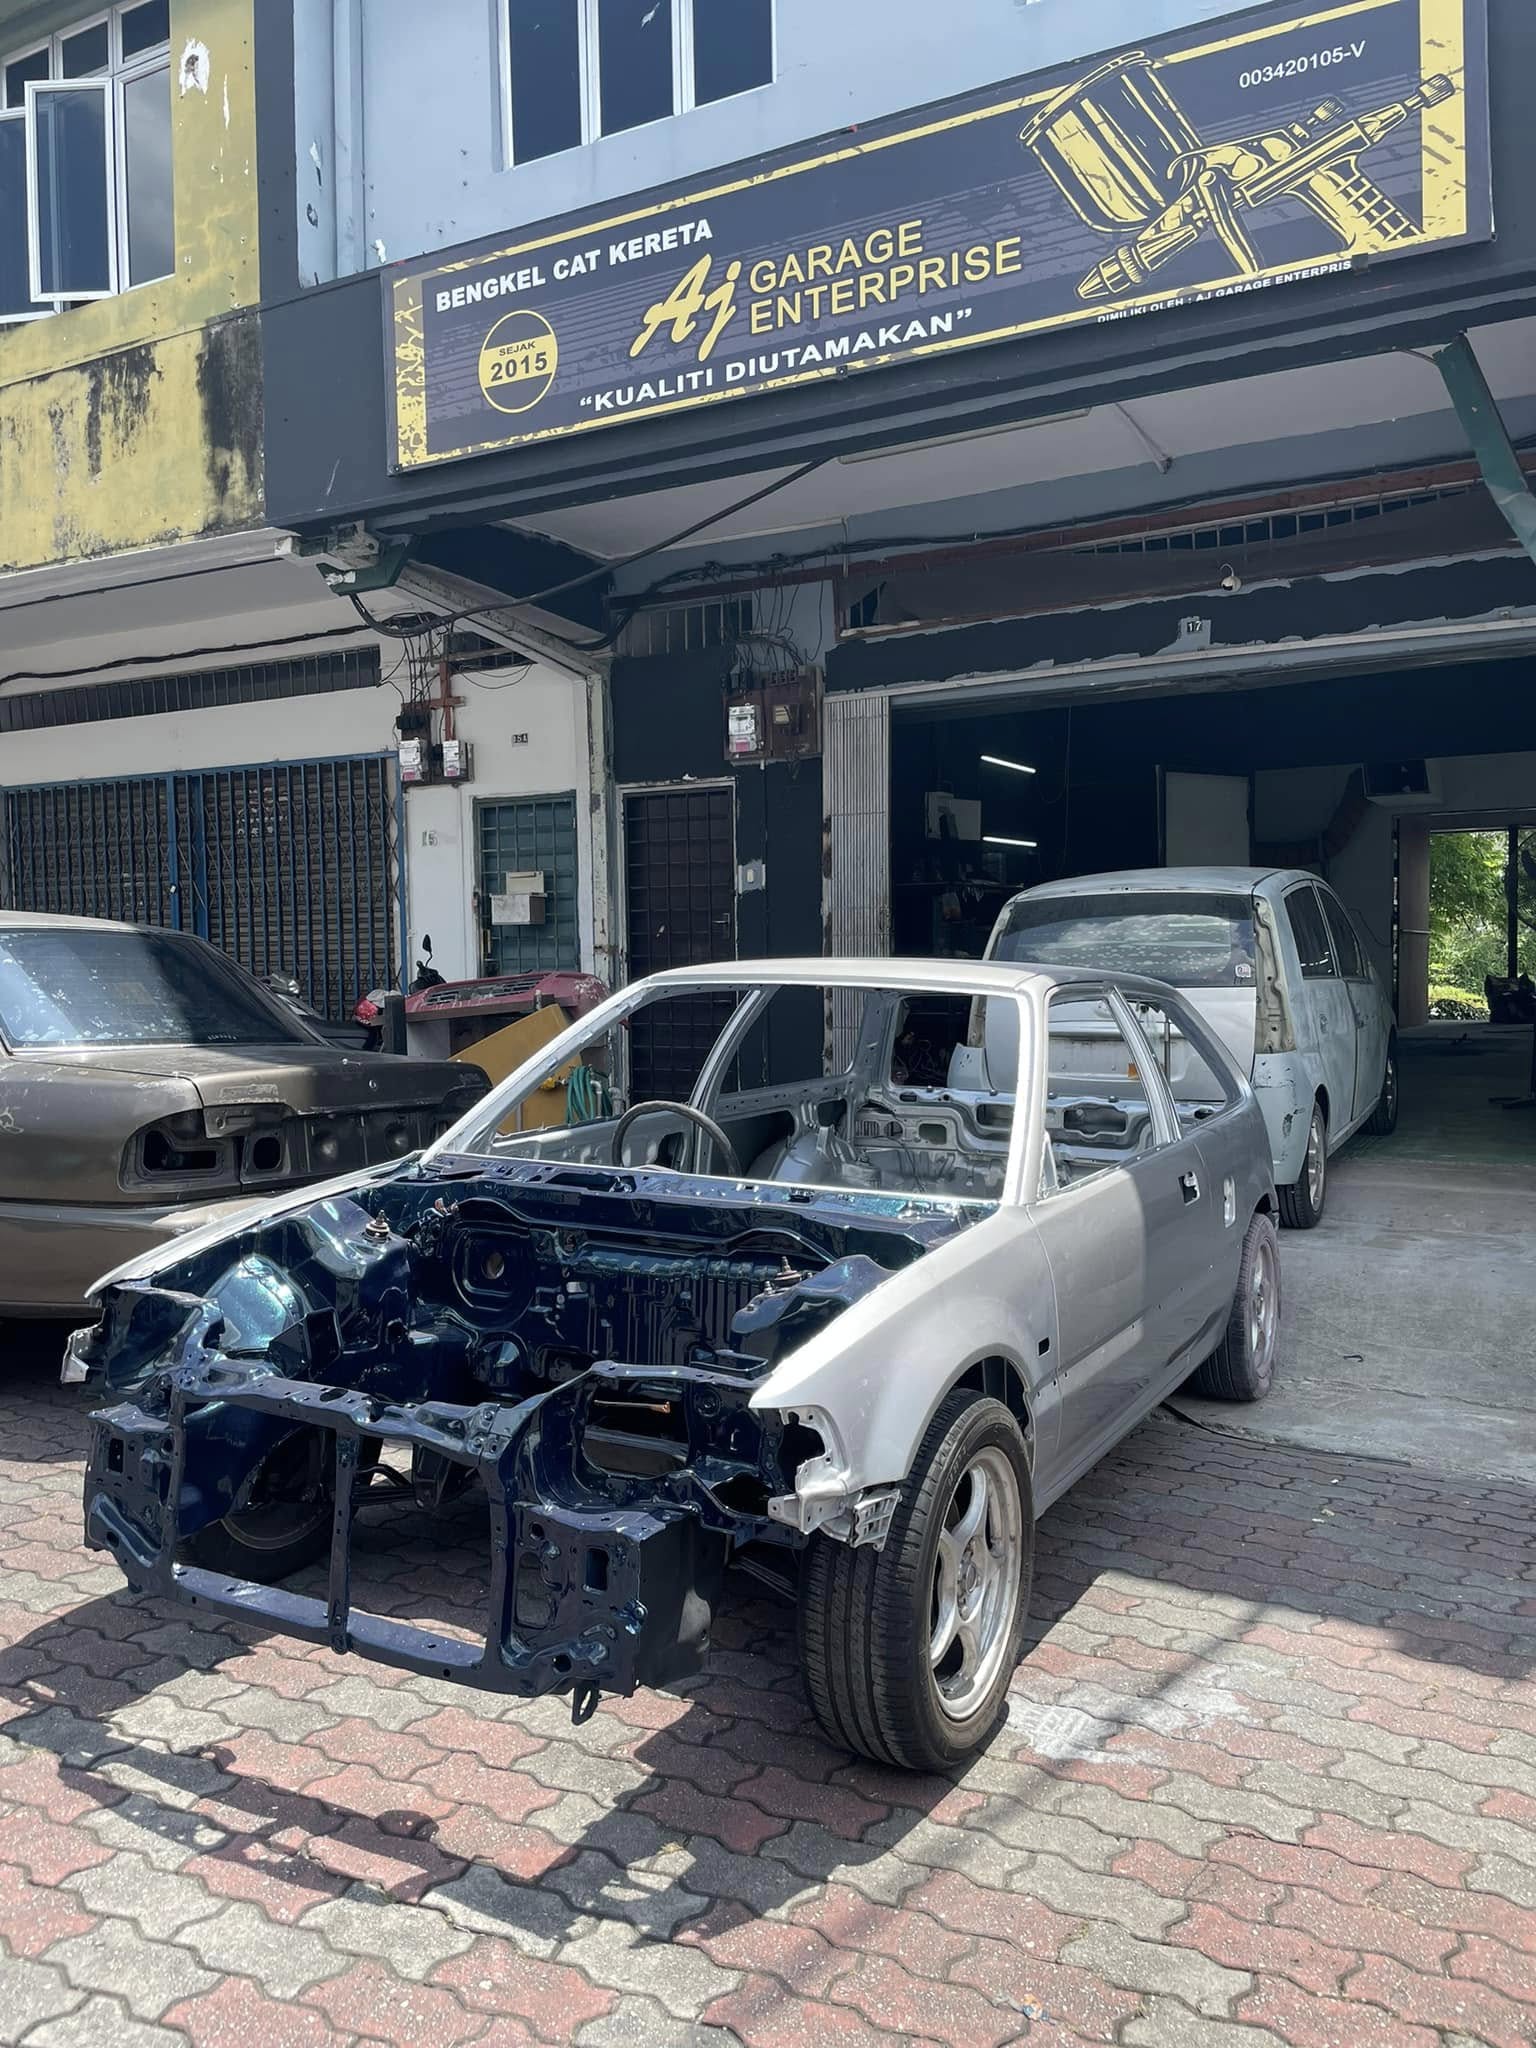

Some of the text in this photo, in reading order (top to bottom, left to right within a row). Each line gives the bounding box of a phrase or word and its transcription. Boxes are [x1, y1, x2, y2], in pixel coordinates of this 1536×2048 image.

[1239, 40, 1366, 88] 003420105-V
[436, 219, 713, 312] BENGKEL CAT KERETA
[630, 219, 923, 362] Aj GARAGE
[750, 236, 1023, 334] ENTERPRISE
[1097, 306, 1147, 323] DIMILIKI
[1150, 297, 1184, 312] OLEH
[1195, 292, 1213, 302] AJ
[1215, 278, 1272, 297] GARAGE
[1275, 260, 1352, 285] ENTERPRIS
[490, 351, 548, 382] 2015
[498, 341, 536, 357] SEJAK
[1188, 620, 1202, 632] 17
